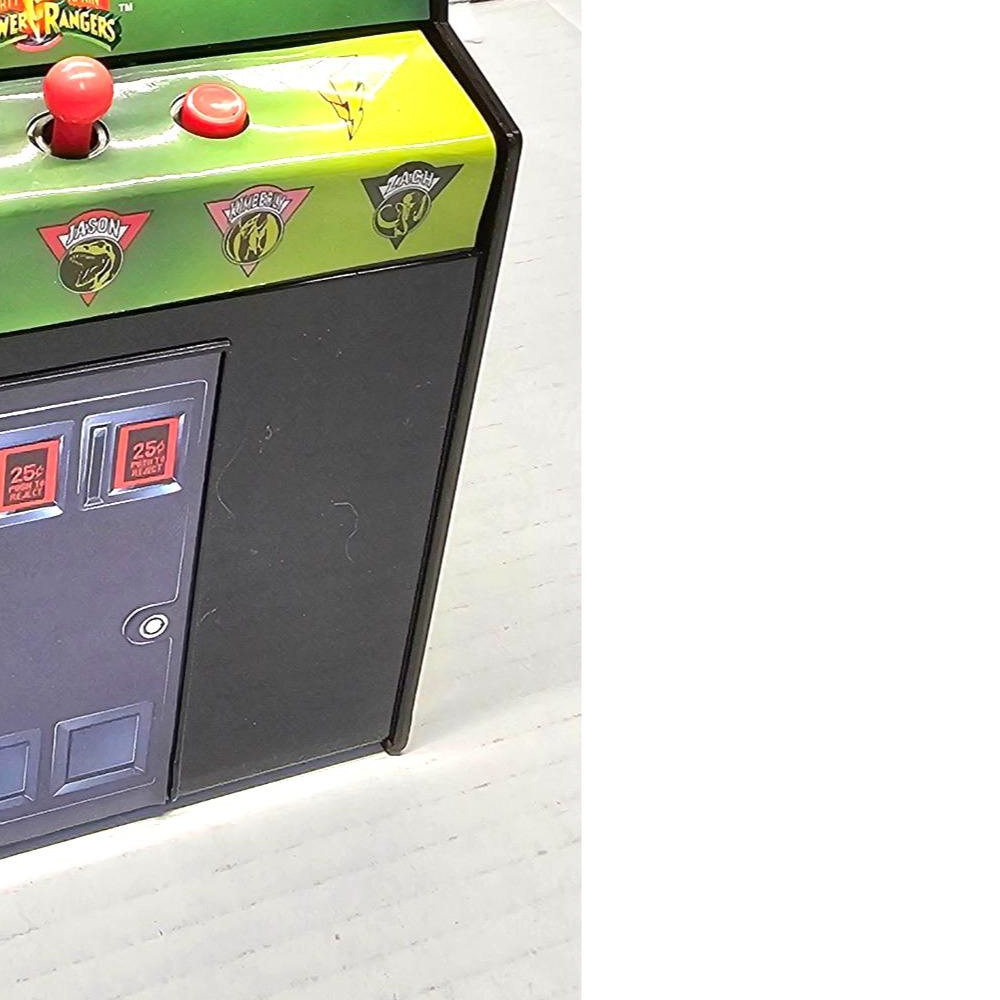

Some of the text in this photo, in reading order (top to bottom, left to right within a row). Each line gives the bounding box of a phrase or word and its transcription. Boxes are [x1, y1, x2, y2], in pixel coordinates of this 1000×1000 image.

[44, 1, 116, 43] RANGERS
[386, 169, 435, 194] ZACH
[66, 216, 121, 246] JASON
